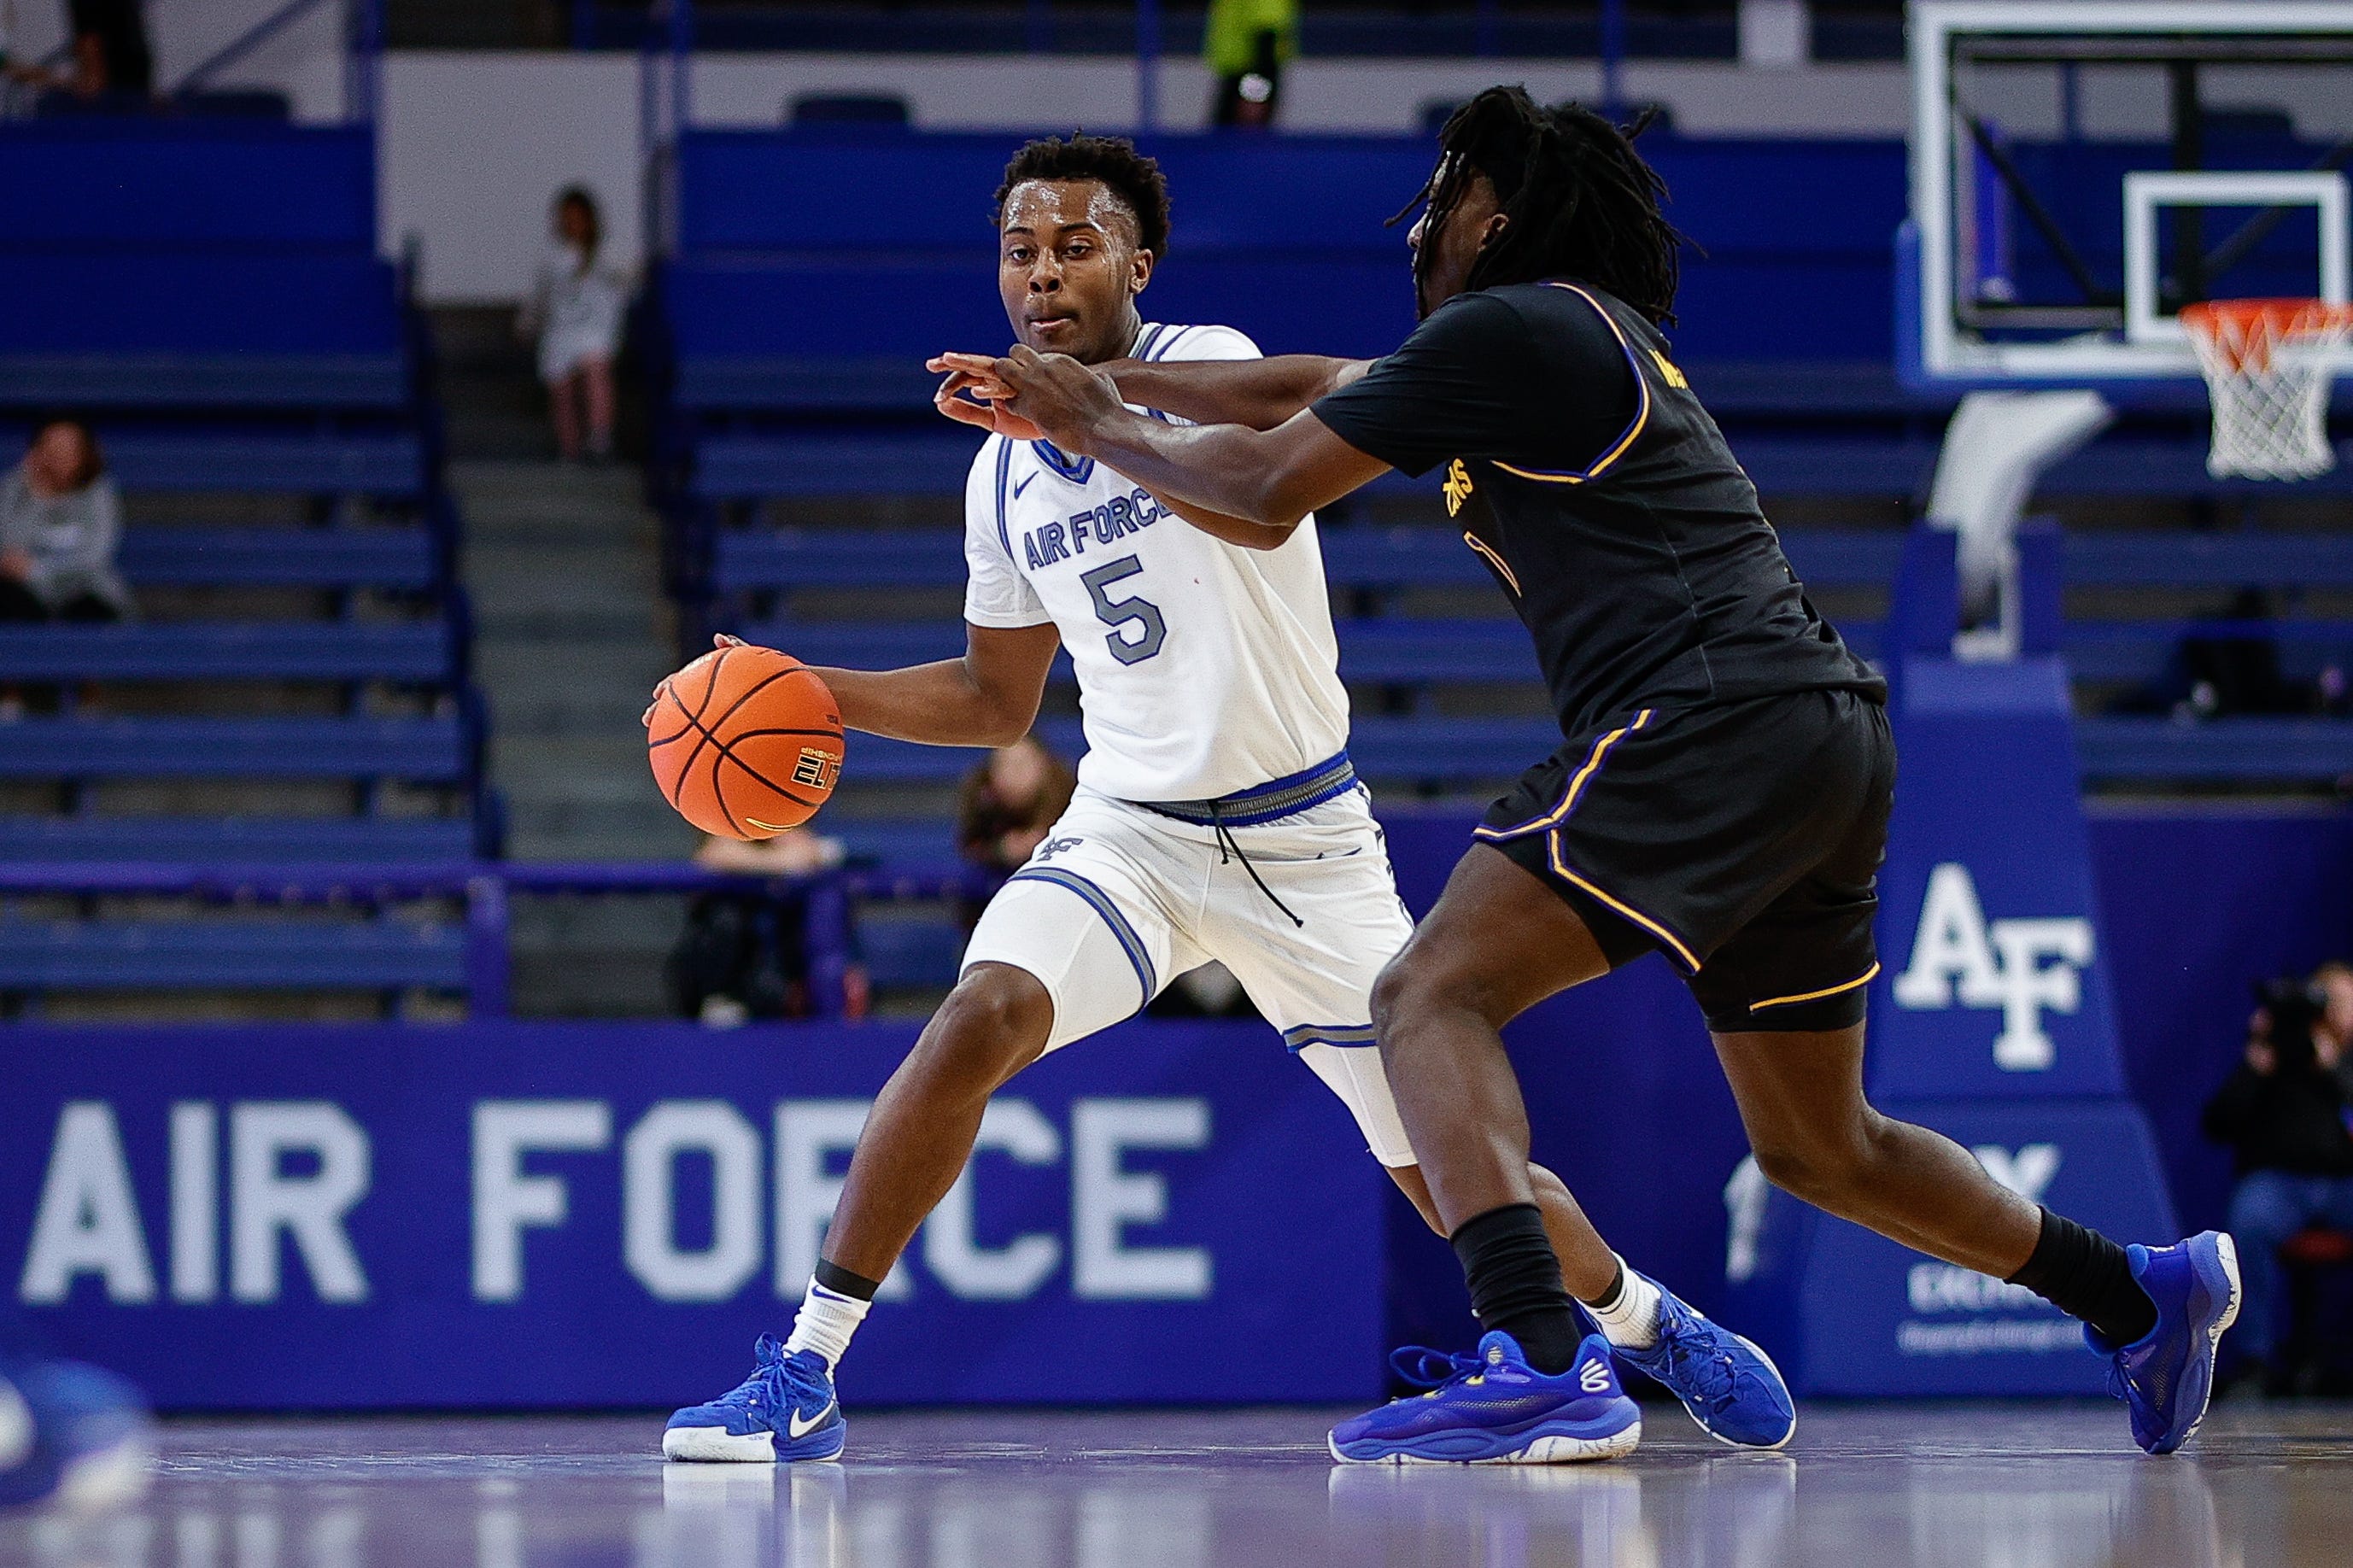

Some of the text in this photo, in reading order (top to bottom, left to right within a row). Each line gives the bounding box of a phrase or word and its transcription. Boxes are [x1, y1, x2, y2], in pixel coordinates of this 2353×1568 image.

[1024, 520, 1071, 570] AIR
[1080, 553, 1168, 666] 5
[1893, 862, 2096, 1070] AF
[20, 1098, 372, 1303] AIR
